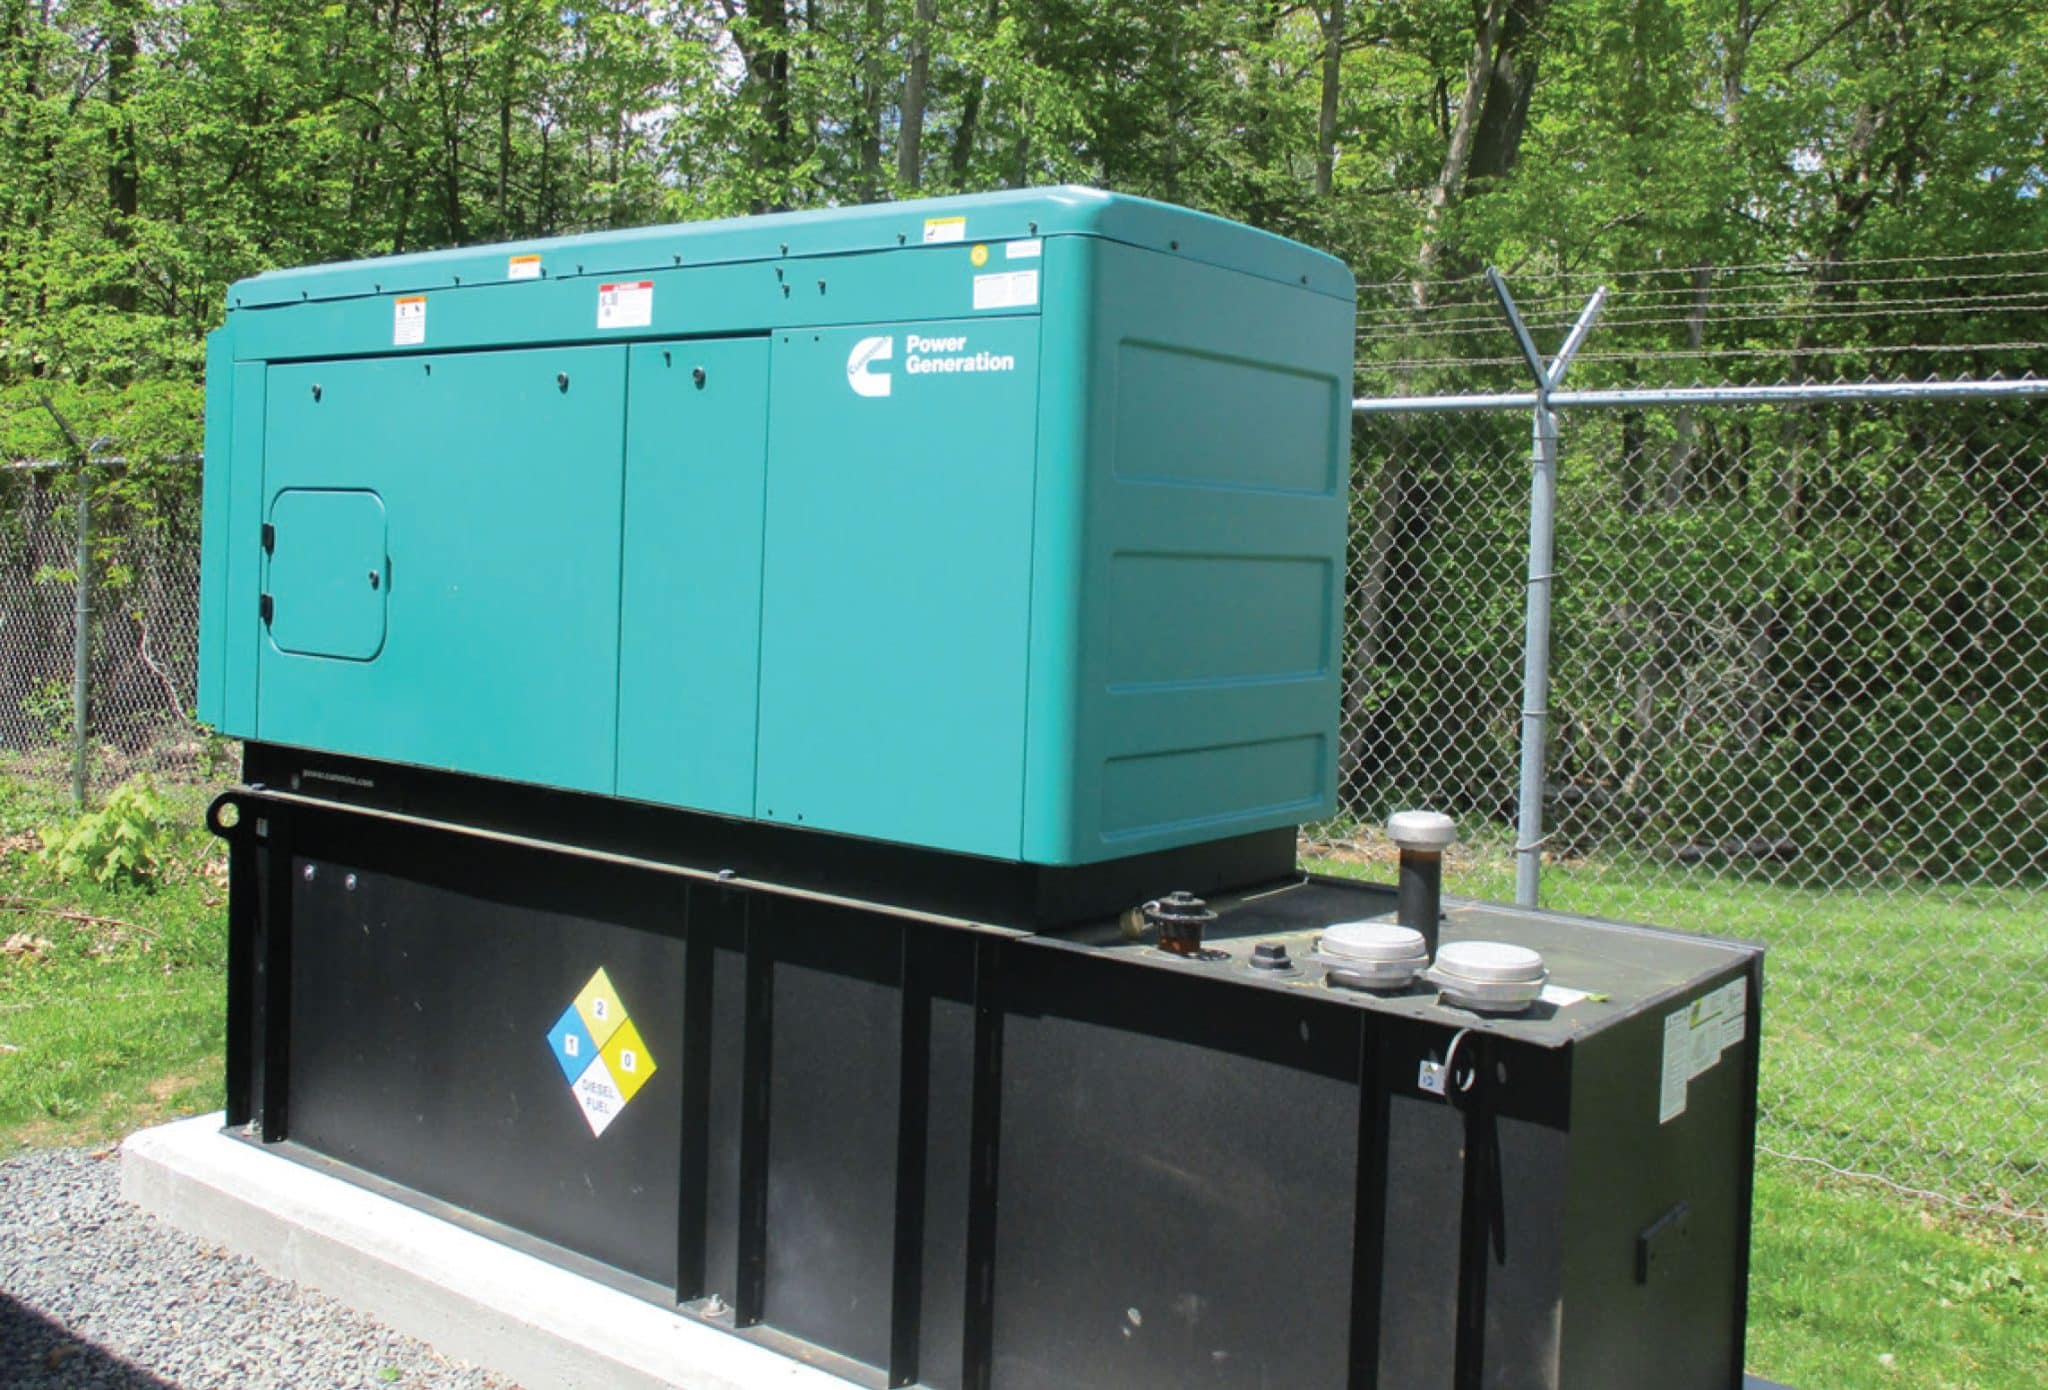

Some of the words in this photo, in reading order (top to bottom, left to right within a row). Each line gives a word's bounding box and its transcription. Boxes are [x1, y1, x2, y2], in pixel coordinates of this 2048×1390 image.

[906, 335, 967, 353] Power
[905, 352, 1014, 374] Generation
[596, 1001, 604, 1016] 2
[568, 1037, 575, 1050] 1
[624, 1053, 632, 1068] 0
[582, 1079, 615, 1099] DIESEL
[586, 1096, 610, 1114] FUEL
